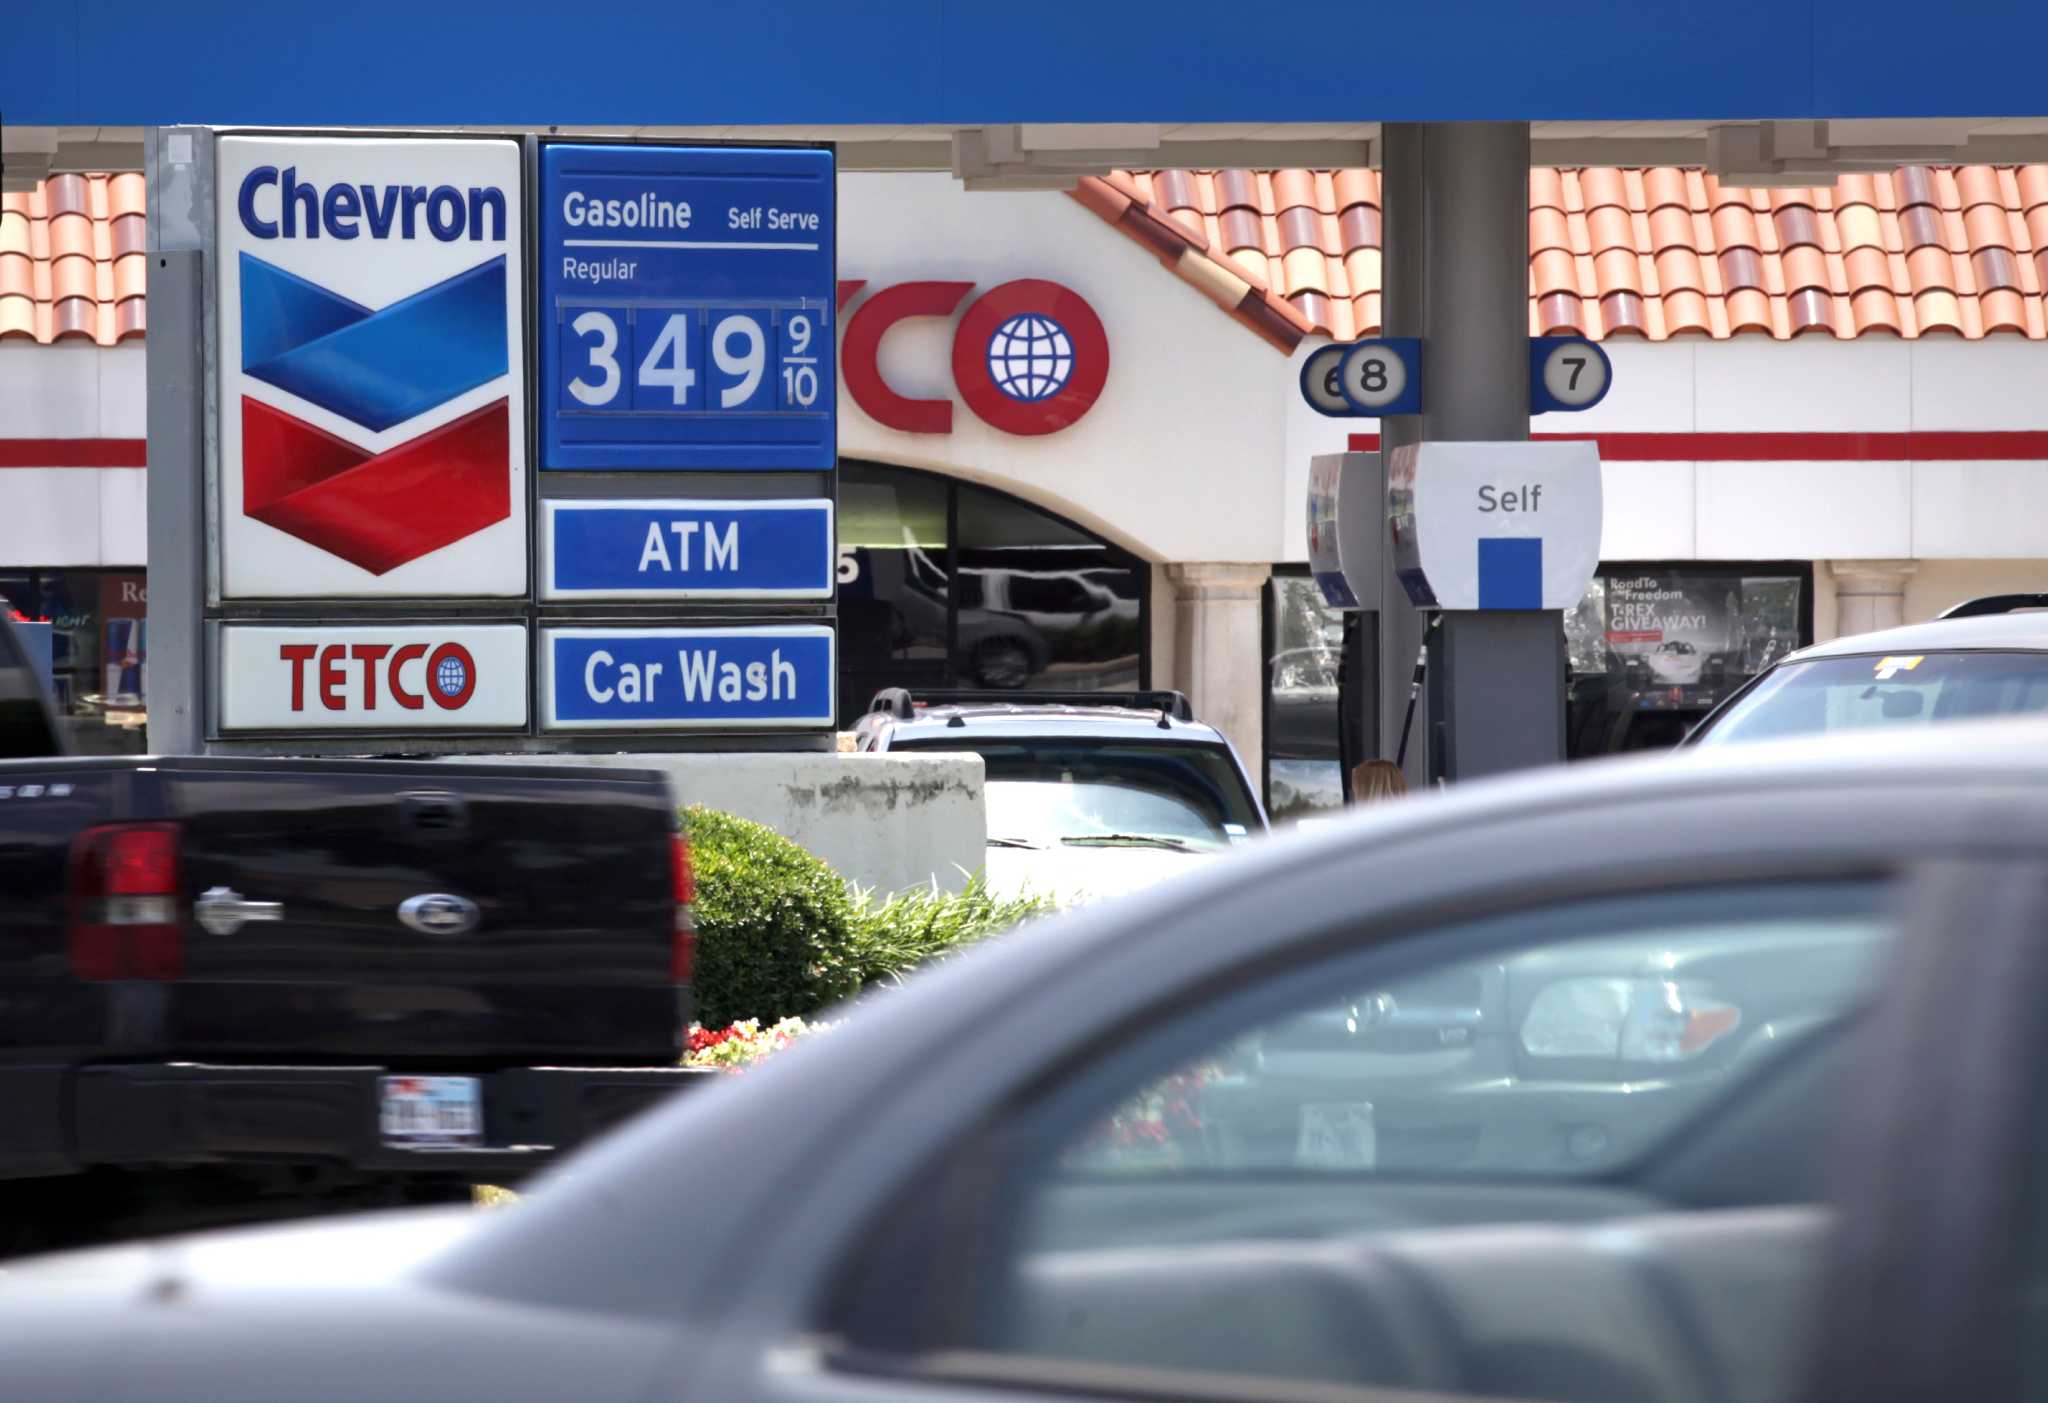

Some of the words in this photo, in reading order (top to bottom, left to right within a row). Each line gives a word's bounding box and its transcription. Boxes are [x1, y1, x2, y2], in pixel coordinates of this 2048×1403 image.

[238, 166, 506, 242] Chevron
[563, 191, 692, 229] Gasoline
[728, 207, 762, 230] Self
[767, 208, 820, 230] Serve
[563, 257, 637, 284] Regular
[838, 278, 1110, 436] CO
[1562, 358, 1587, 390] 7
[1360, 359, 1388, 392] 8
[1477, 484, 1542, 513] Self
[638, 521, 739, 572] ATM
[1624, 588, 1683, 601] Freedom
[1611, 615, 1707, 631] GIVEAWAY!
[280, 641, 477, 711] TETCO
[585, 650, 663, 704] Car
[678, 648, 797, 702] Wash
